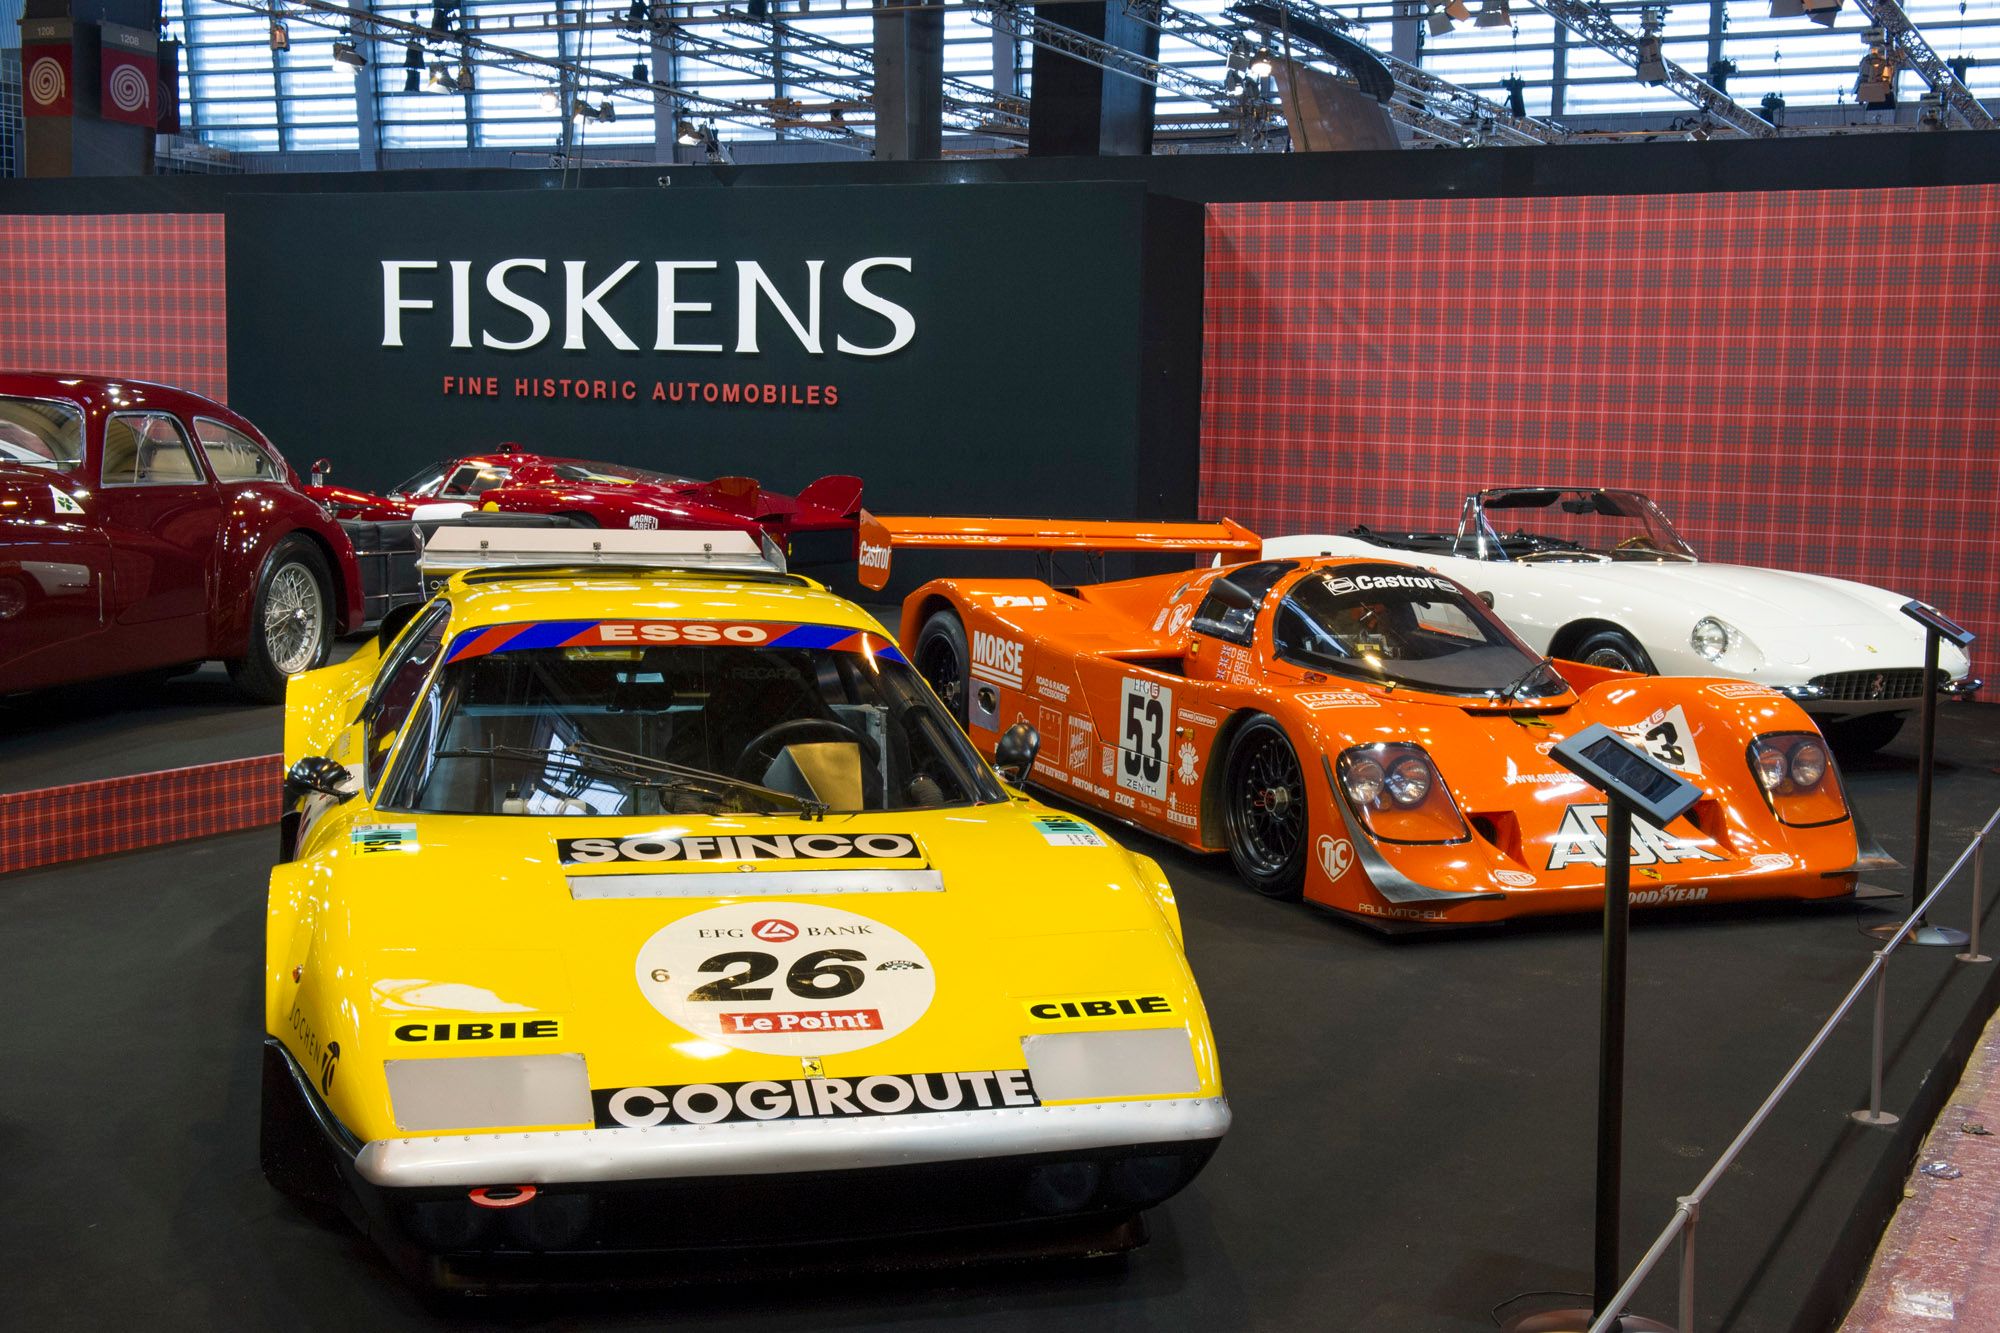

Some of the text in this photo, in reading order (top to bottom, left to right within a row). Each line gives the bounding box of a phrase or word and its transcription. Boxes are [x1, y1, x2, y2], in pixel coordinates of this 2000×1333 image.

[381, 257, 916, 356] FISKENS
[443, 376, 839, 406] FINE HISTORIC AUTOMOBILES
[859, 540, 892, 570] Castrol
[1355, 574, 1435, 590] Castrol
[599, 624, 768, 643] ESSO
[973, 630, 1024, 675] MORSE
[1236, 649, 1253, 664] BELL
[1233, 661, 1250, 676] BELL
[1125, 693, 1164, 784] 53
[1645, 721, 1686, 766] 3
[1126, 778, 1158, 797] ZENITH
[570, 834, 914, 863] SOFINCO
[1321, 841, 1348, 875] TLC
[1628, 884, 1709, 905] OODYEAR
[1357, 903, 1448, 920] PAUL MITCHELL
[698, 924, 873, 939] EFG BANK
[651, 968, 671, 983] 6
[685, 948, 868, 1002] 26
[289, 1001, 322, 1065] JOCHEN
[732, 1010, 872, 1032] Le Point
[608, 1068, 1035, 1128] COGIROUTE
